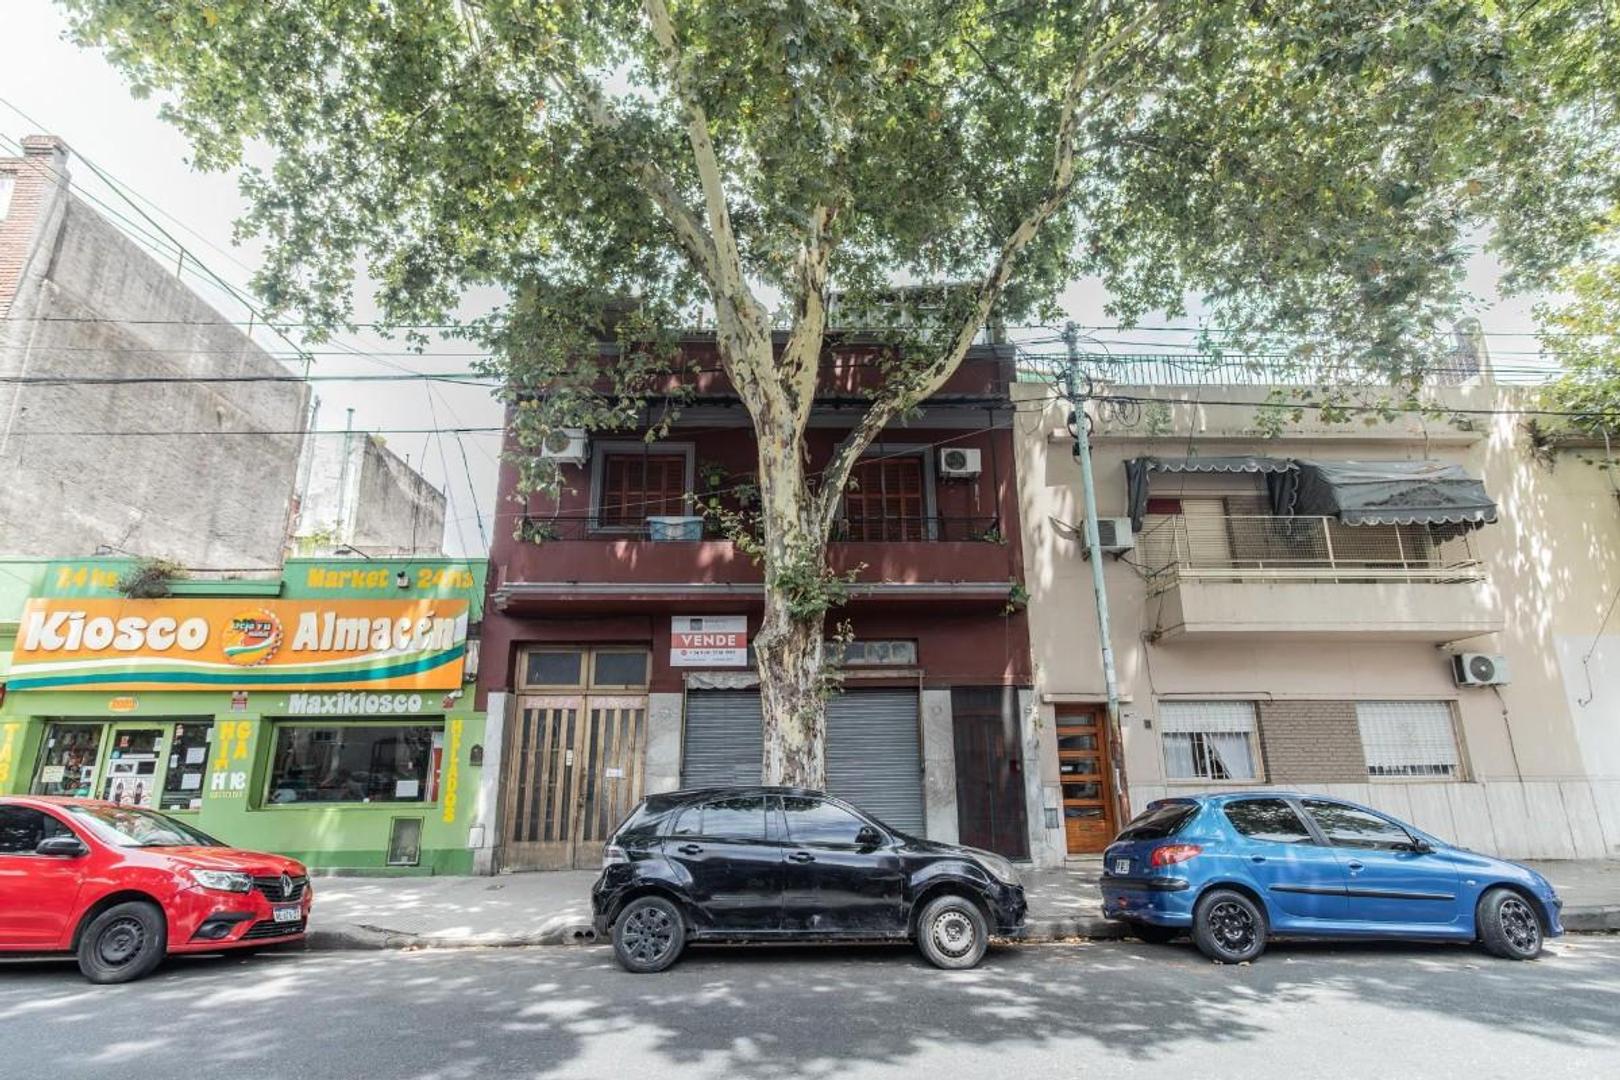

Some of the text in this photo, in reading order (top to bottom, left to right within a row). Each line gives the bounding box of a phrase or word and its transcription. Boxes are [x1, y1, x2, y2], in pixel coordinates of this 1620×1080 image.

[307, 567, 389, 588] Market
[24, 611, 456, 651] Kiosco Almacén
[681, 634, 736, 647] VENDE
[288, 692, 422, 714] Maxikiosco
